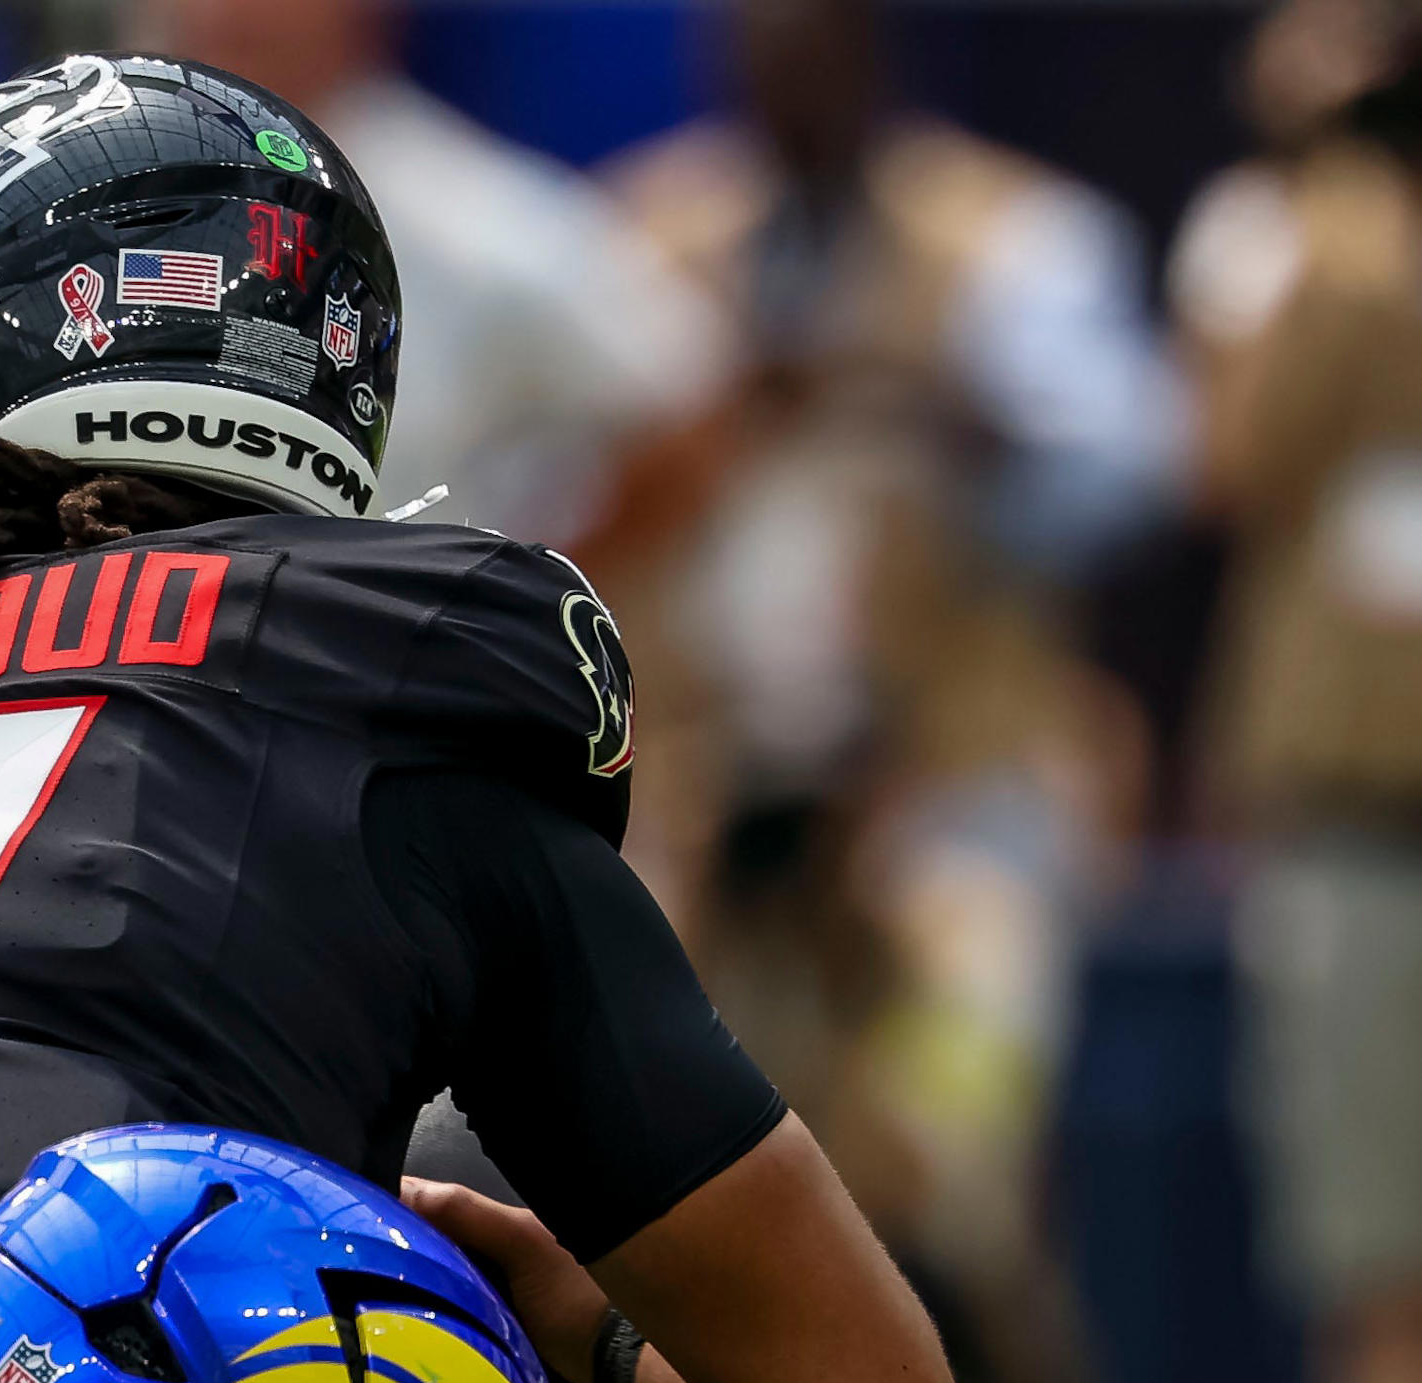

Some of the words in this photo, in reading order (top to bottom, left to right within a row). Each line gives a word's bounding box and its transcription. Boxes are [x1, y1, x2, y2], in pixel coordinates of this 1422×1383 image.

[252, 316, 300, 335] WARNING
[327, 322, 354, 359] NFL
[75, 411, 374, 516] HOUSTON
